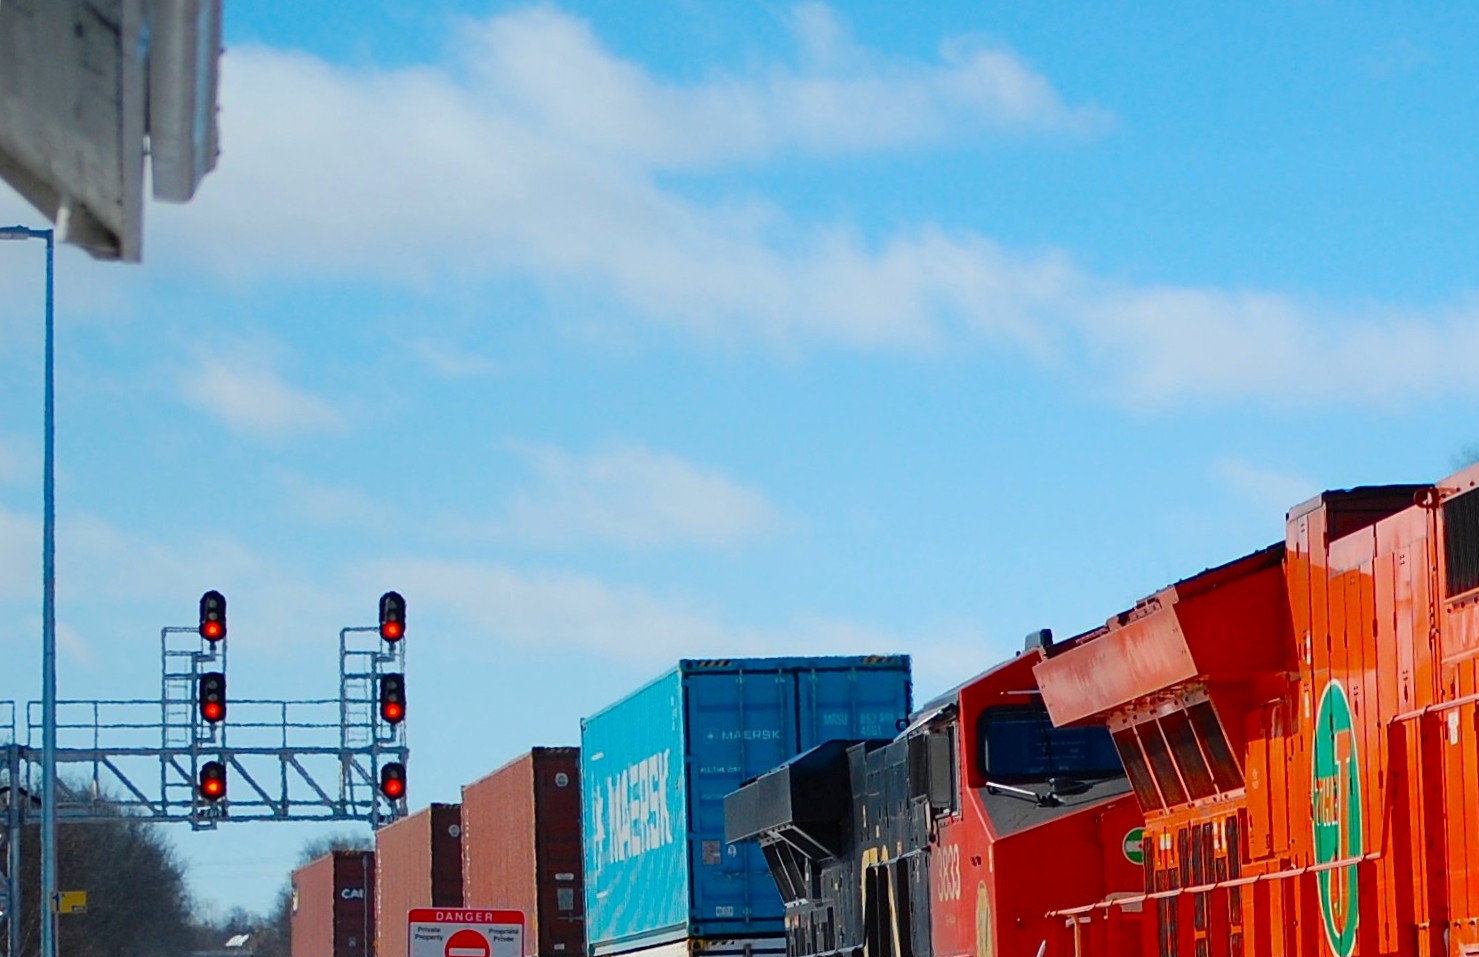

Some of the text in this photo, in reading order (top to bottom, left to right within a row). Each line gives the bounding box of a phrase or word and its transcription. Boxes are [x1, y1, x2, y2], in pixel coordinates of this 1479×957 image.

[722, 729, 782, 741] MAERSK
[607, 747, 674, 864] MAERSK
[341, 887, 364, 899] CAI
[435, 911, 493, 922] DANGER
[417, 926, 442, 934] Private
[415, 934, 444, 942] Property
